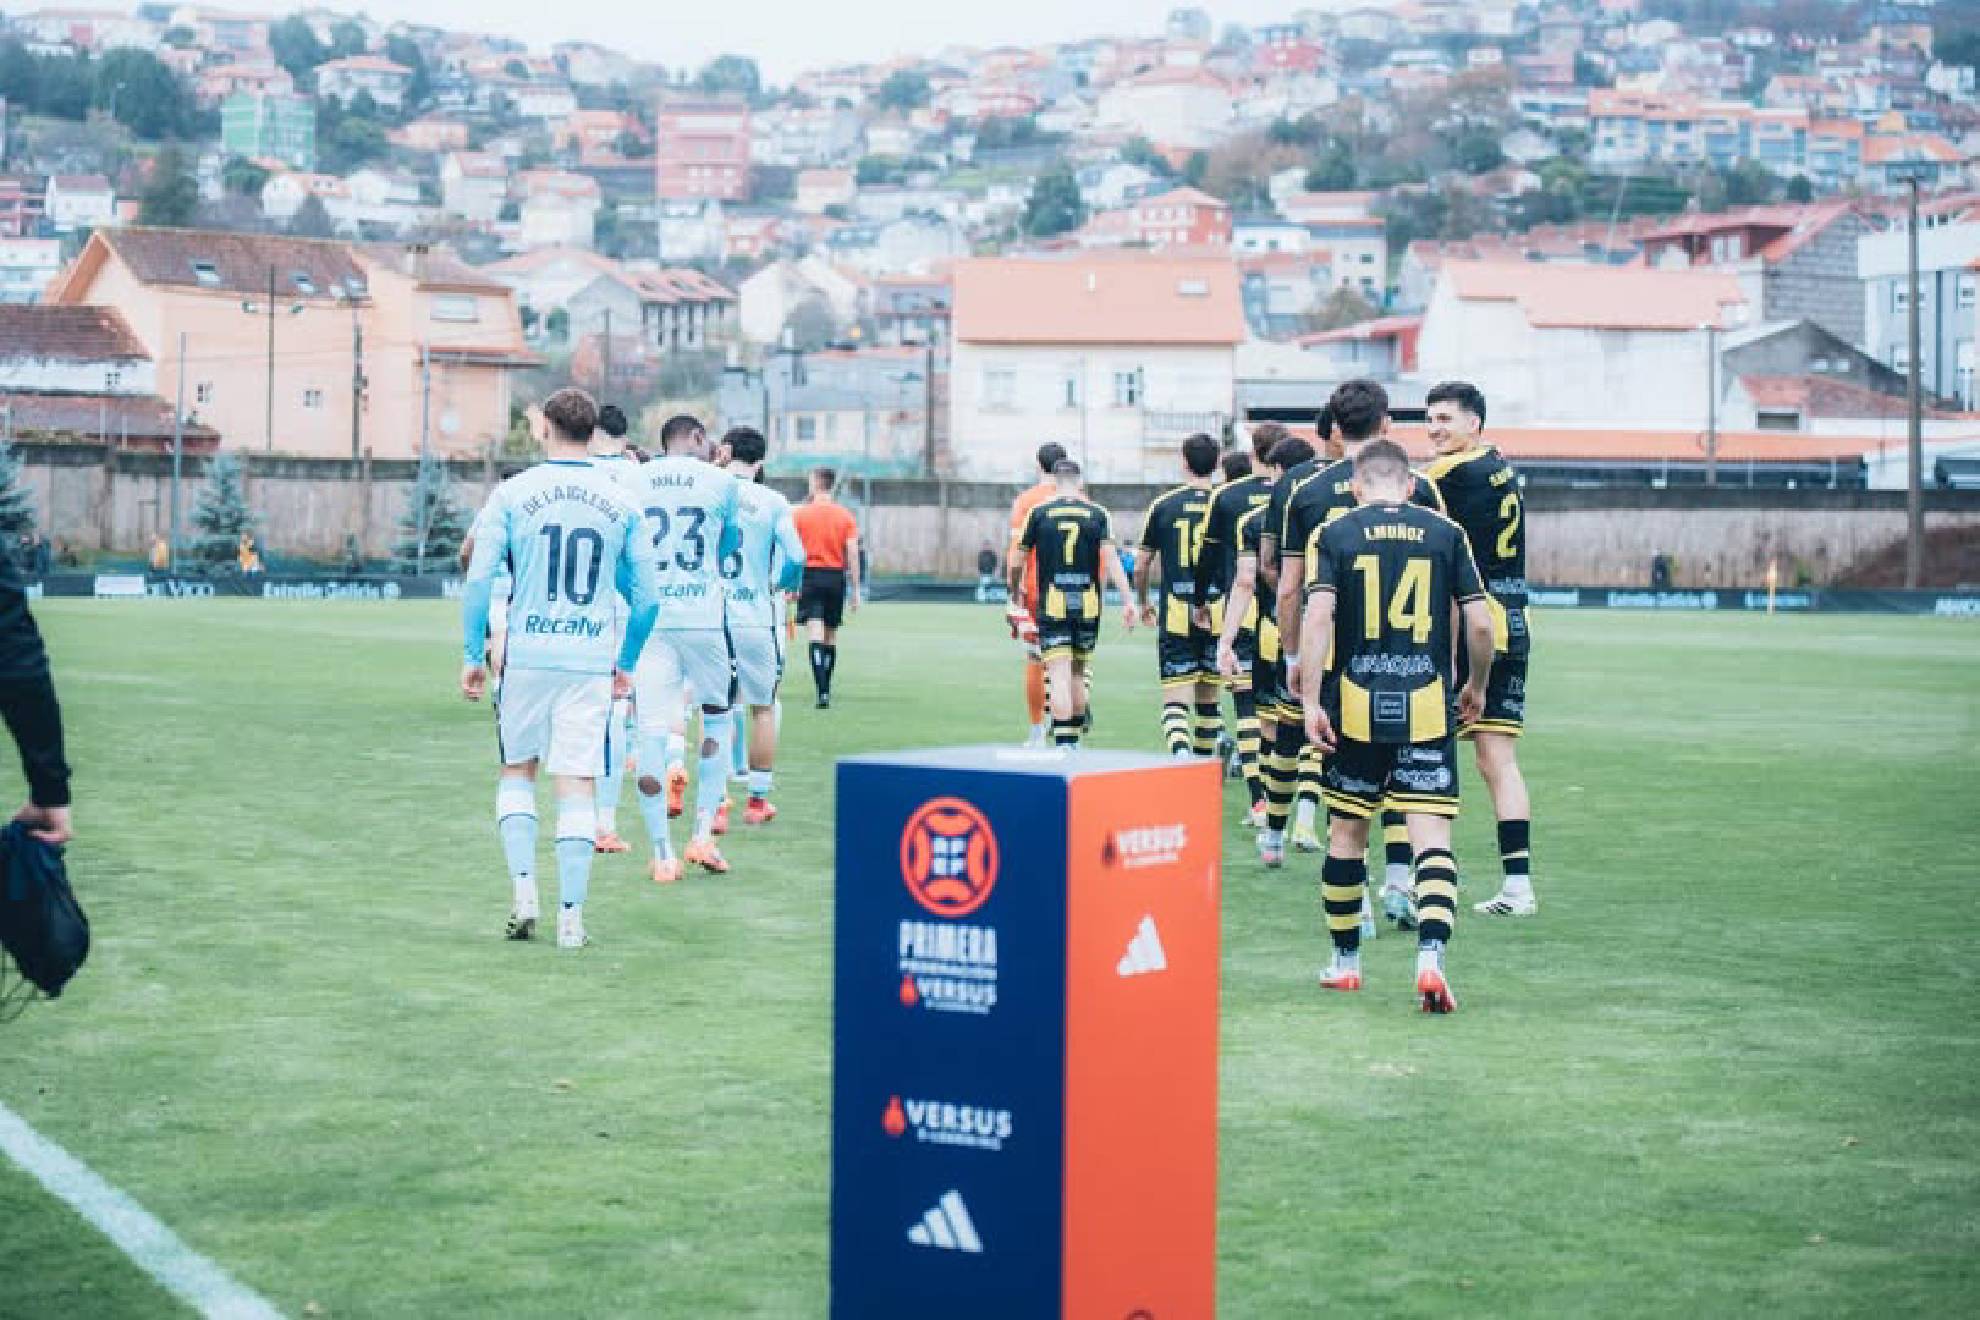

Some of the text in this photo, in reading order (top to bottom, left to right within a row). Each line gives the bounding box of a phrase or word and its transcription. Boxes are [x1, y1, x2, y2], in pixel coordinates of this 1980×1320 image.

[644, 506, 706, 571] 23
[1057, 522, 1080, 566] 7
[1497, 493, 1520, 558] 2
[540, 523, 604, 605] 10
[1353, 554, 1433, 644] 14
[1115, 824, 1188, 855] VERSUS
[898, 920, 998, 964] PRIMERA
[917, 979, 998, 1006] VERSUS
[906, 1099, 1013, 1139] VERSUS
